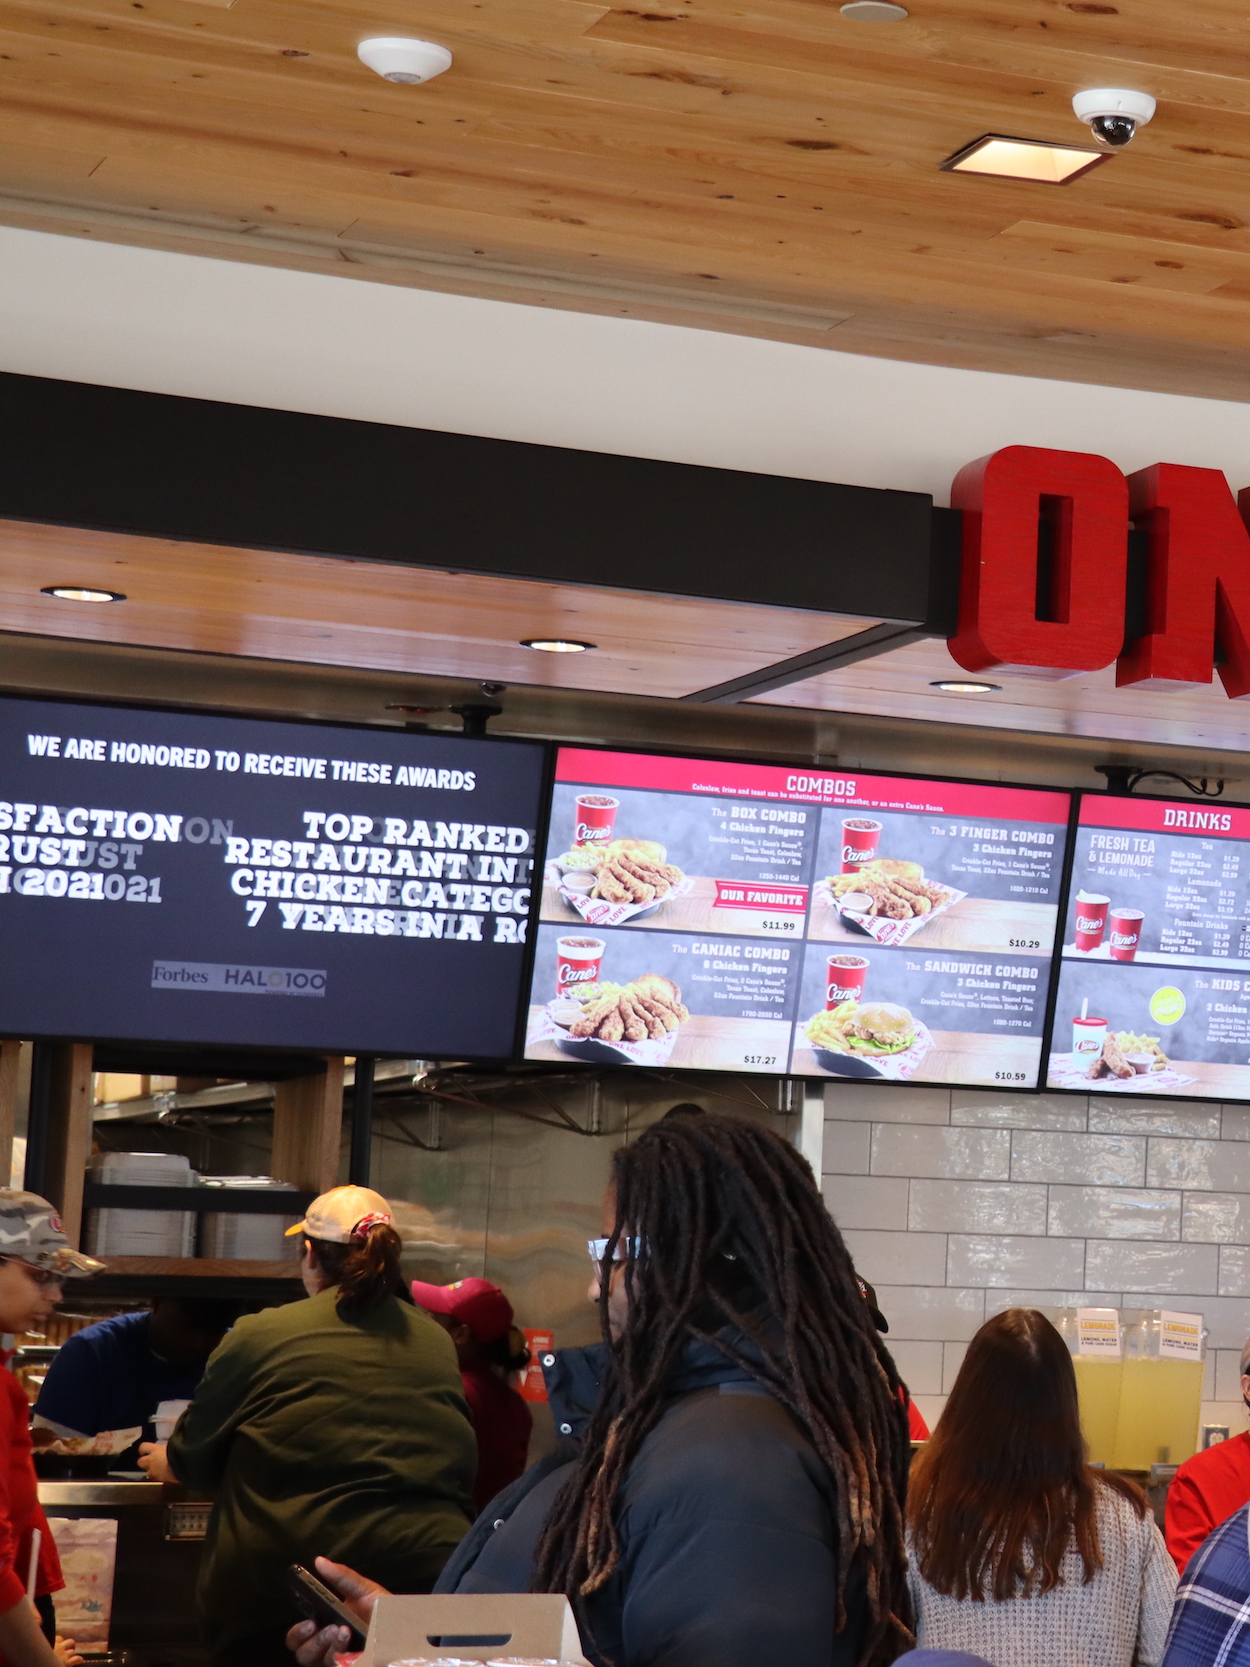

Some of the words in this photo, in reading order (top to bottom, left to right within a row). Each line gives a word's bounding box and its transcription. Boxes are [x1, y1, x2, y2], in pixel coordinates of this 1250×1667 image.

[28, 734, 61, 757] WE
[65, 738, 106, 762] ARE
[111, 742, 210, 770] HONORED
[215, 750, 240, 772] TO
[244, 753, 327, 780] RECEIVE
[332, 759, 391, 785] THESE
[395, 765, 476, 792] AWARDS
[786, 775, 857, 796] COMBOS
[692, 783, 720, 793] Coleslaw,
[722, 785, 736, 794] fries
[751, 789, 766, 797] toast
[789, 793, 822, 802] substituted
[823, 794, 832, 803] for
[846, 797, 870, 806] another,
[889, 801, 904, 809] extra
[906, 802, 924, 811] Cane's
[925, 804, 944, 812] Sauce.
[711, 807, 727, 817] The
[731, 806, 758, 820] BOX
[761, 809, 807, 824] COMBO
[1163, 809, 1232, 831] DRINKS
[304, 811, 373, 842] TOP
[383, 817, 530, 854] RANKED
[576, 822, 612, 841] Cane's
[720, 821, 727, 830] 4
[730, 821, 766, 834] Chicken
[769, 825, 804, 837] Fingers
[931, 826, 946, 836] The
[949, 825, 958, 837] 3
[961, 826, 1008, 842] FINGER
[1012, 830, 1055, 845] COMBO
[709, 836, 739, 845] Crinkle-Cut
[741, 838, 756, 846] Fries,
[763, 840, 780, 848] Cane's
[1090, 834, 1129, 852] FRESH
[1133, 837, 1155, 854] TEA
[1201, 842, 1214, 850] Tea
[842, 845, 875, 864] Cane's
[973, 843, 980, 852] 3
[982, 844, 1017, 856] Chicken
[1019, 847, 1053, 859] Fingers
[1088, 850, 1097, 863] &
[1099, 851, 1155, 867] LEMONADE
[225, 837, 467, 879] RESTAURANT
[477, 855, 518, 884] IN
[790, 874, 800, 882] Cal
[1098, 866, 1116, 876] Made
[1128, 868, 1141, 880] Day
[231, 868, 392, 905] CHICKEN
[1040, 886, 1049, 894] Cal
[1187, 877, 1222, 888] Lemonade
[721, 889, 745, 901] OUR
[747, 891, 803, 906] FAVORITE
[246, 900, 267, 927] 7
[278, 903, 394, 936] YEARS
[455, 913, 484, 941] A
[762, 921, 795, 931] $11.99
[1076, 915, 1103, 932] Cane's
[1174, 918, 1204, 929] Fountain
[1205, 920, 1228, 930] Drinks
[1009, 939, 1040, 949] $10.29
[1110, 932, 1137, 950] Cane's
[672, 944, 688, 954] The
[691, 943, 741, 957] CANIAC
[744, 946, 790, 961] COMBO
[558, 963, 598, 984] Cane's
[703, 960, 710, 969] 6
[712, 960, 750, 972] Chicken
[752, 963, 788, 975] Fingers
[905, 961, 921, 972] The
[924, 960, 992, 976] SANDWICH
[995, 965, 1039, 980] COMBO
[153, 966, 208, 985] Forbes
[224, 969, 326, 990] HALO100
[957, 978, 964, 987] 3
[966, 978, 1001, 990] Chicken
[1003, 981, 1036, 993] Fingers
[1195, 980, 1209, 989] The
[1212, 978, 1241, 991] KIDS
[827, 982, 861, 1002] Cane's
[1206, 1003, 1213, 1012] 2
[1214, 1003, 1248, 1014] Chicken
[744, 1055, 777, 1065] $17.27
[995, 1071, 1026, 1081] $10.59
[1081, 1321, 1116, 1331] LEMONADE
[1163, 1322, 1199, 1335] LEMONADE
